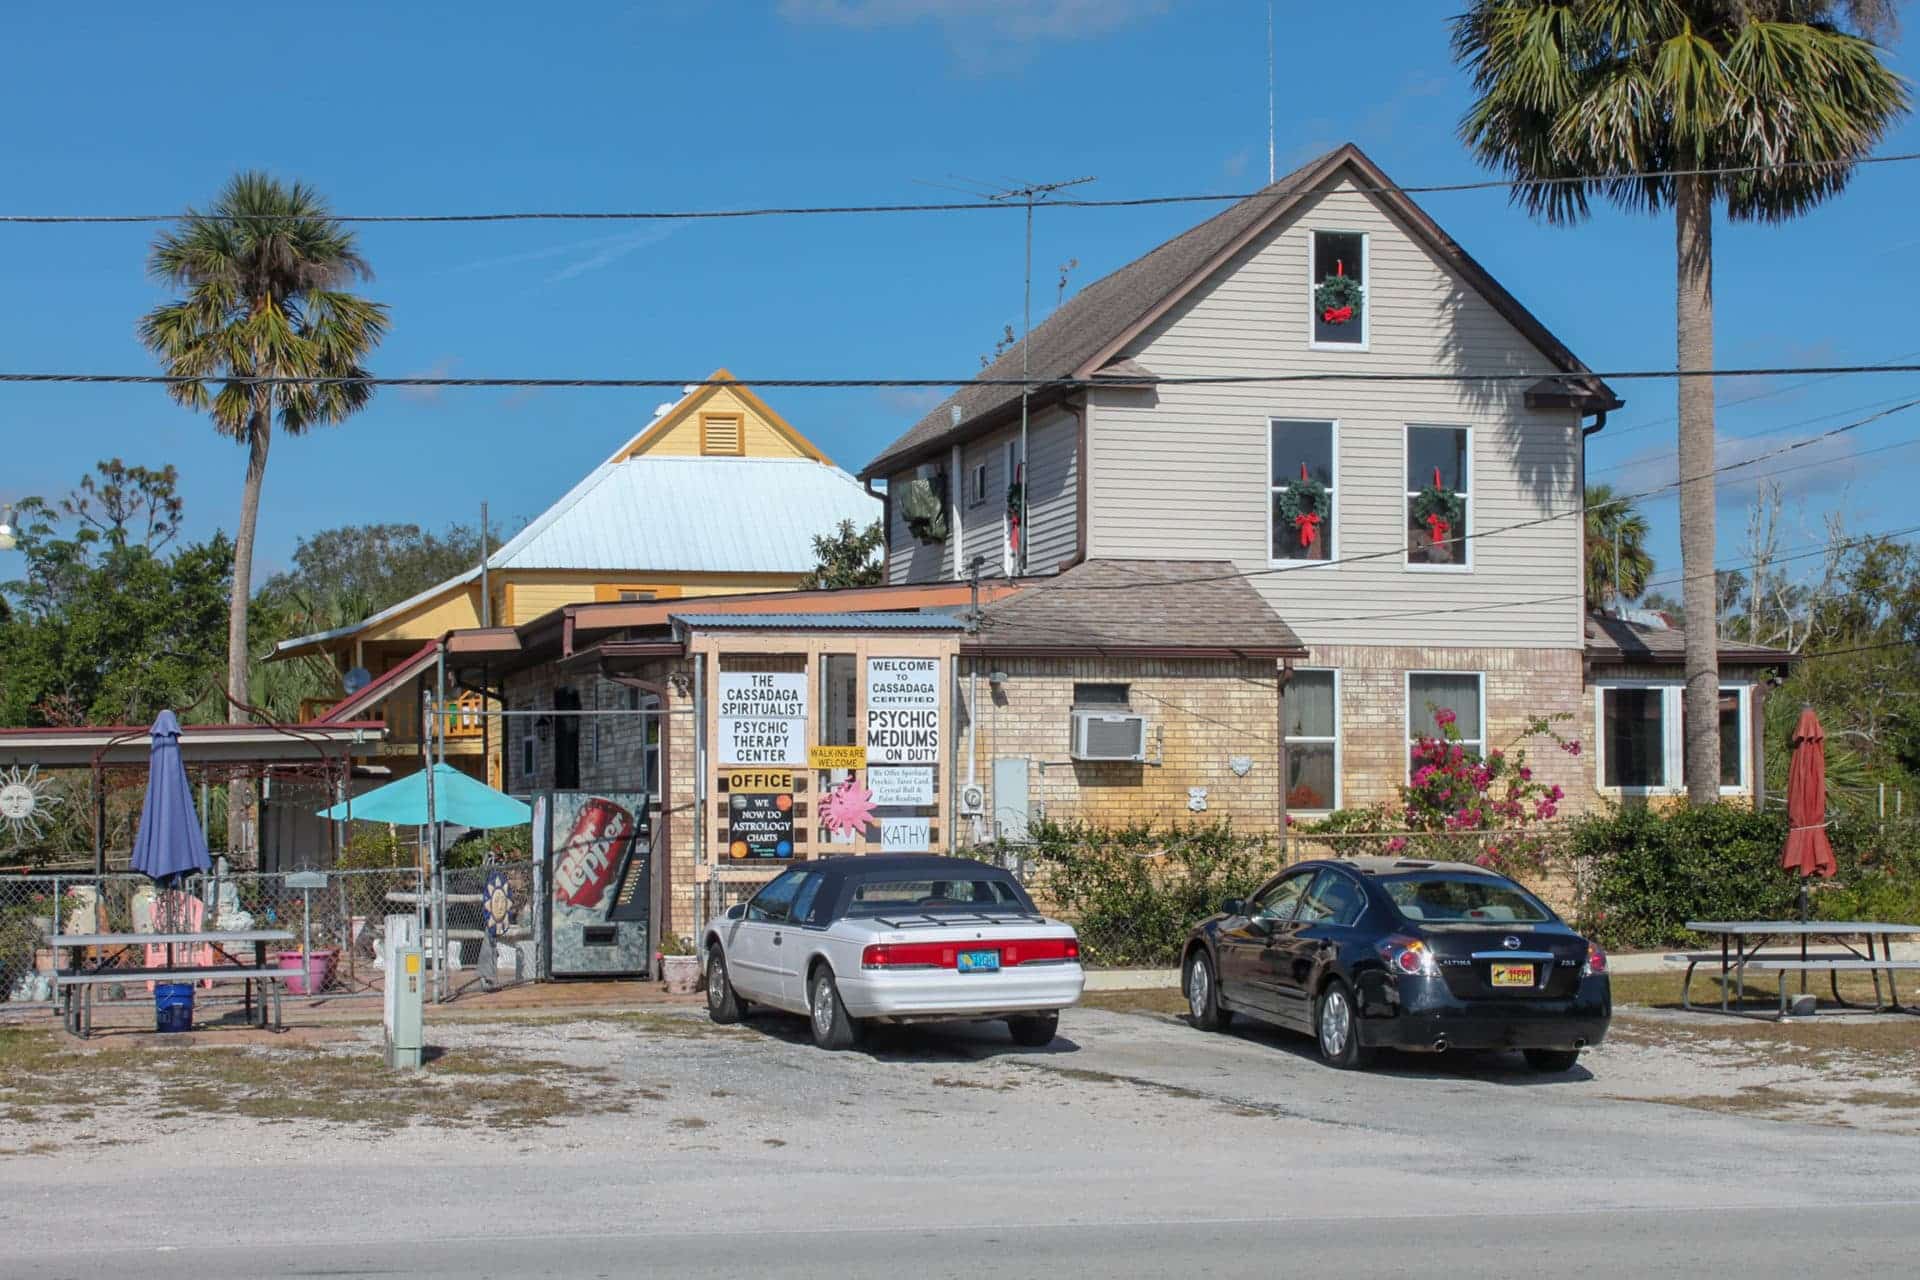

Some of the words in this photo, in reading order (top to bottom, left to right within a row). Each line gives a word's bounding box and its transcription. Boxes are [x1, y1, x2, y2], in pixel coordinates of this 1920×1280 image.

[872, 661, 935, 671] WELCOME
[752, 675, 774, 687] THE
[896, 673, 908, 681] TO
[872, 683, 935, 693] CASSADAGA
[727, 689, 799, 701] CASSADAGA
[722, 703, 804, 715] SPIRITUALIST
[868, 710, 937, 728] PSYCHIC
[734, 721, 788, 734] PSYCHIC
[733, 735, 789, 748] THERAPY
[867, 730, 938, 747] MEDIUMS
[736, 749, 786, 761] CENTER
[849, 749, 865, 758] ARE
[885, 749, 902, 760] ON
[907, 749, 937, 760] DUTY
[818, 759, 857, 768] WELCOME
[731, 774, 792, 787] OFFICE
[754, 799, 769, 807] WE
[742, 811, 765, 819] NOW
[767, 811, 782, 819] DO
[732, 822, 791, 831] ASTROLOGY
[746, 834, 778, 842] CHARTS
[882, 825, 928, 845] KATHY
